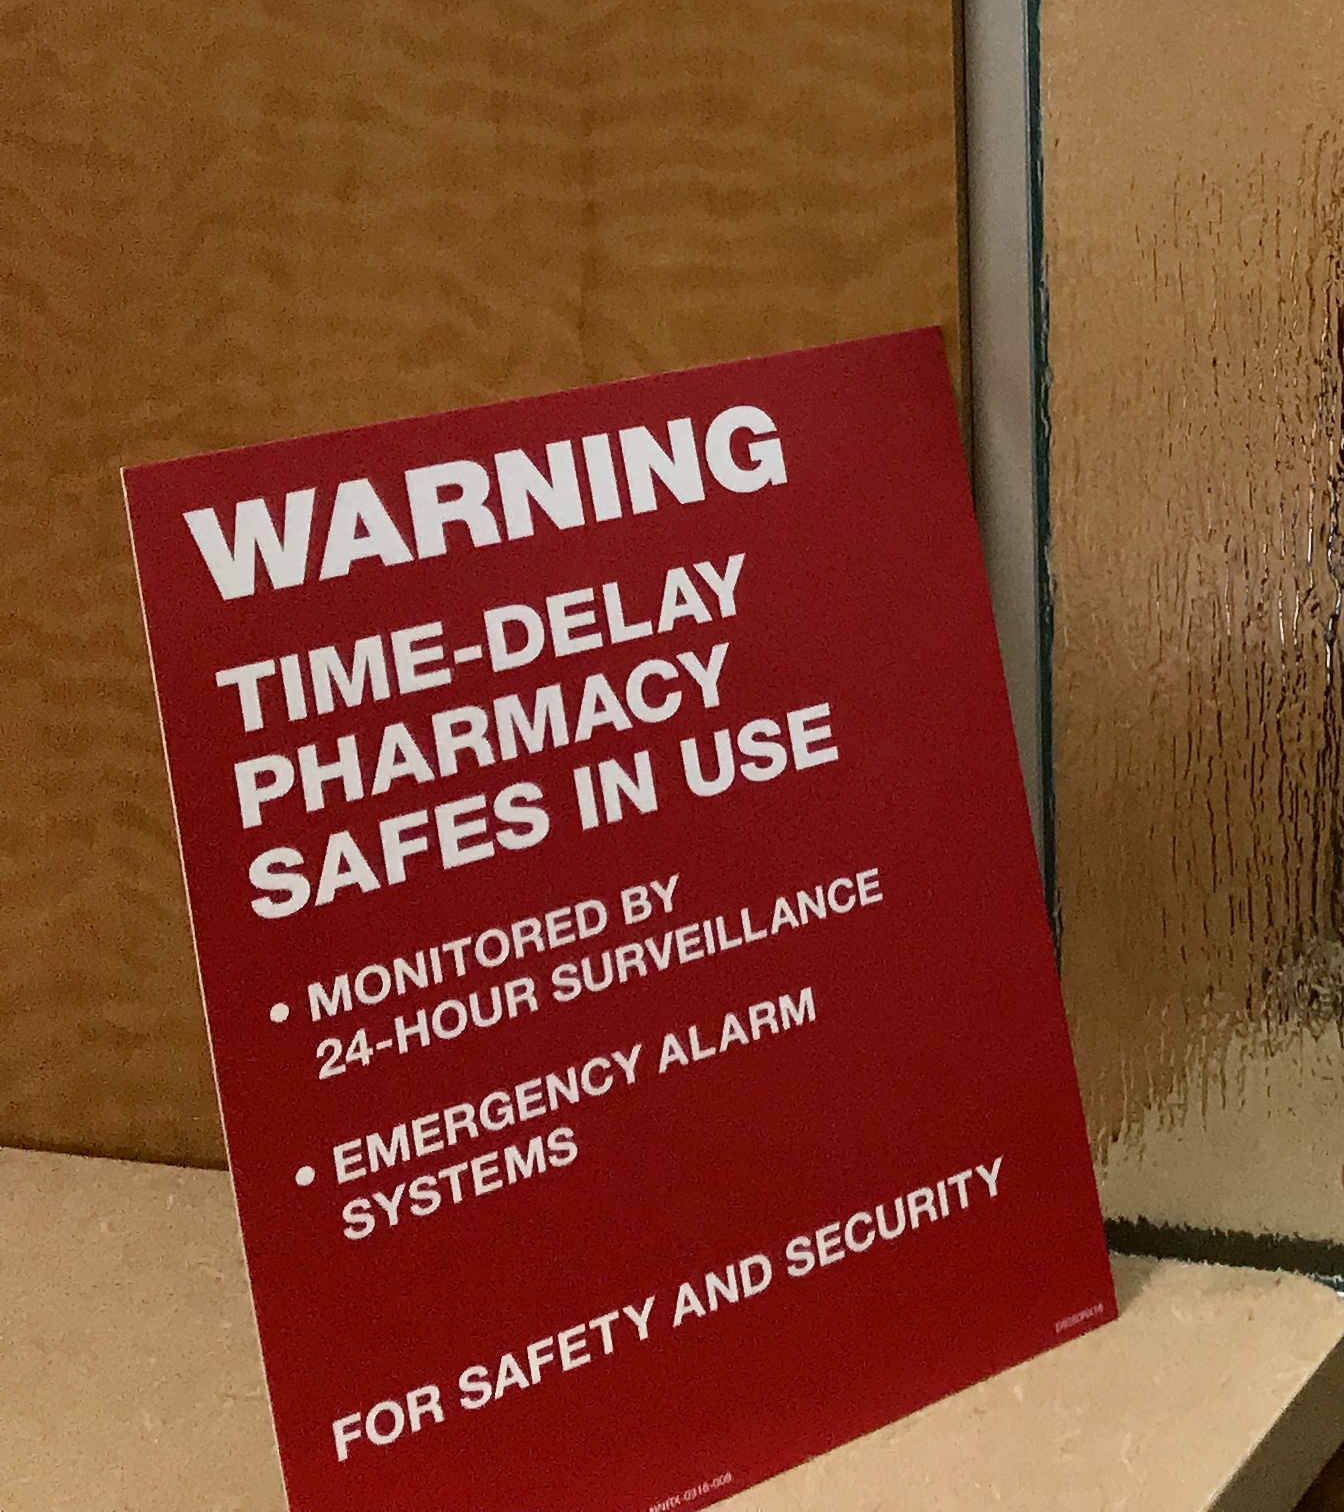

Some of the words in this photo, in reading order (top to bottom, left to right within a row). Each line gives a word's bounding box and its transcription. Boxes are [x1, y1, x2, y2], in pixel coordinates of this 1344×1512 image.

[183, 404, 788, 602] WARNING
[216, 552, 747, 733] TIME-DELAY
[234, 643, 731, 830] PHARMACY
[247, 782, 550, 921] SAFES
[573, 750, 658, 832] IN
[680, 703, 841, 798] USE
[307, 895, 608, 1022] MONITORED
[623, 873, 682, 933] BY
[316, 976, 539, 1080] 24-HOUR
[551, 867, 884, 1004] SURVEILLANCE
[333, 1044, 644, 1185] EMERGENCY
[657, 986, 817, 1075] ALARM
[341, 1126, 580, 1242] SYSTEMS
[332, 1384, 444, 1462] FOR
[458, 1296, 657, 1411] SAFETY
[671, 1252, 773, 1328] AND
[786, 1155, 1006, 1278] SECURITY
